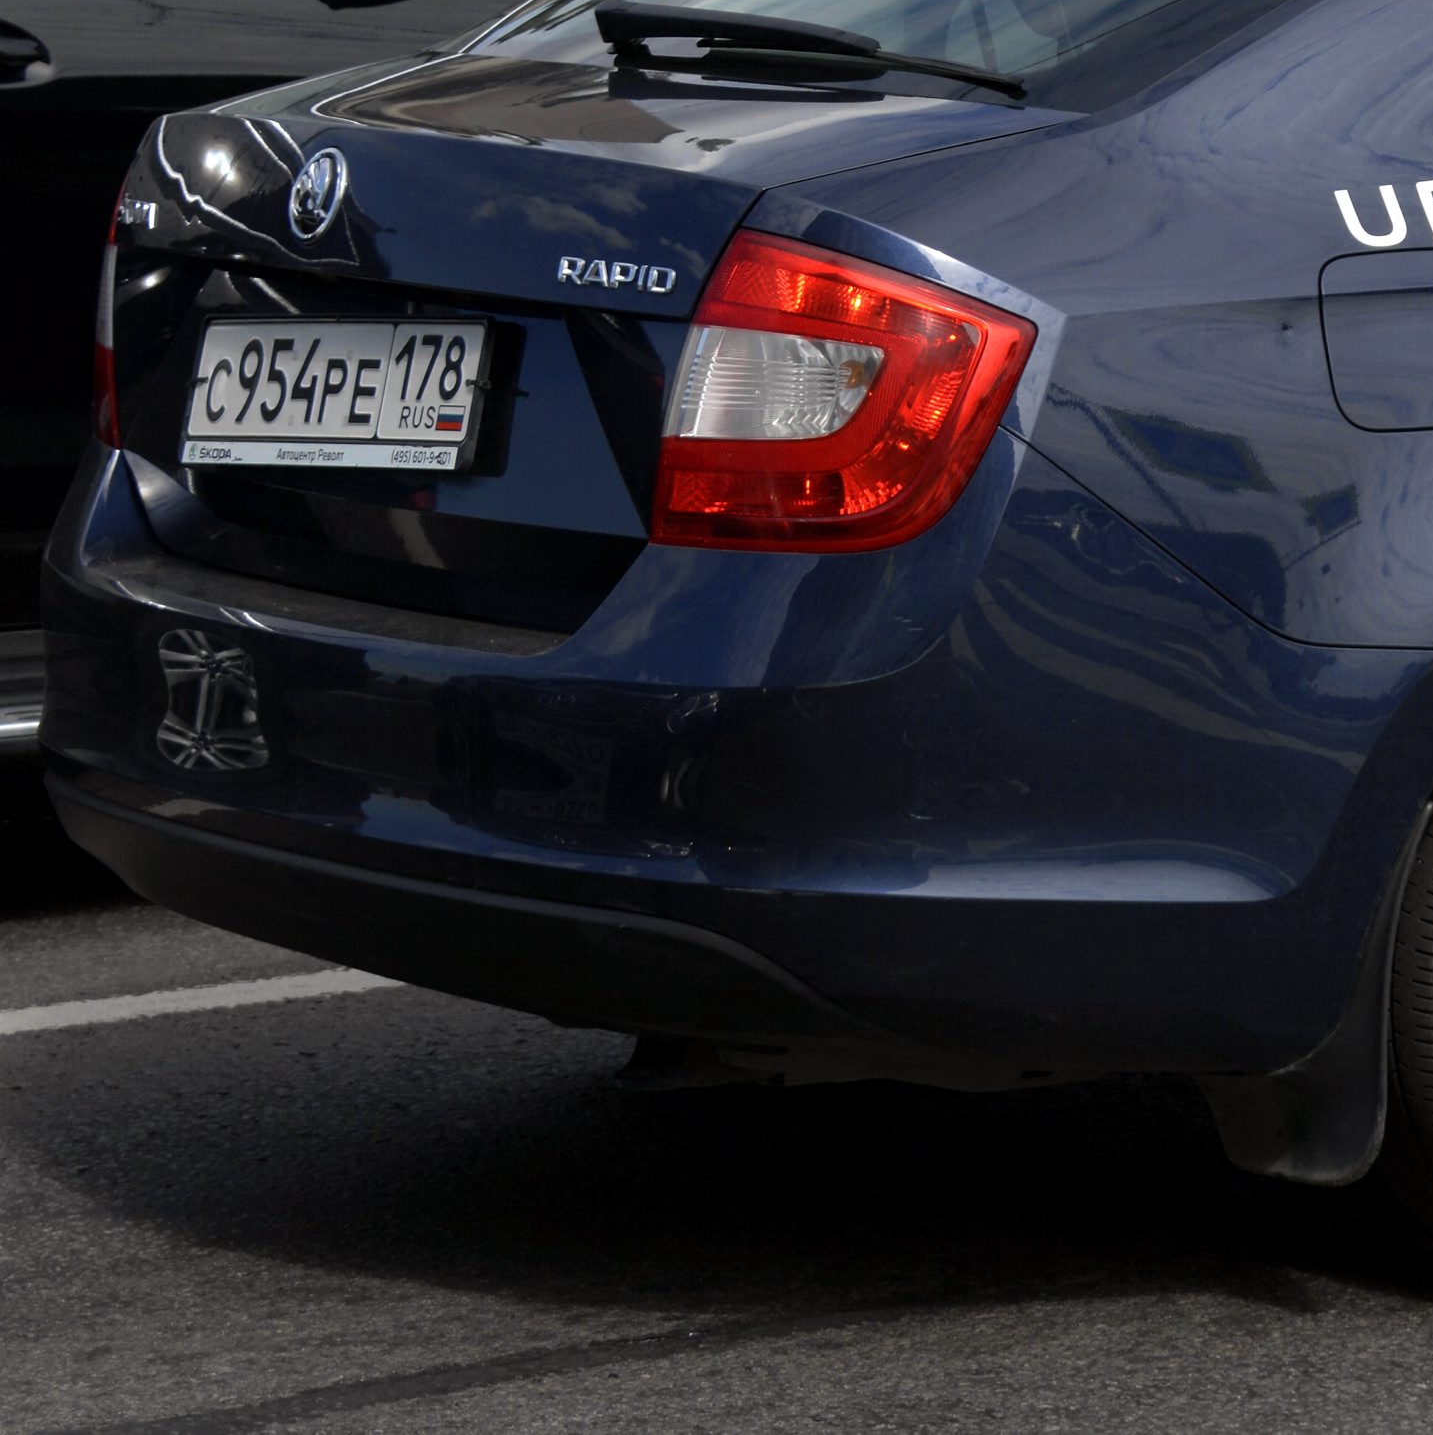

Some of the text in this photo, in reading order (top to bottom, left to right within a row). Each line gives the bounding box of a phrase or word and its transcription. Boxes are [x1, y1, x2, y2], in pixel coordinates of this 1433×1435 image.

[557, 256, 677, 294] RAPID
[394, 334, 466, 402] 178
[398, 405, 436, 429] RUS
